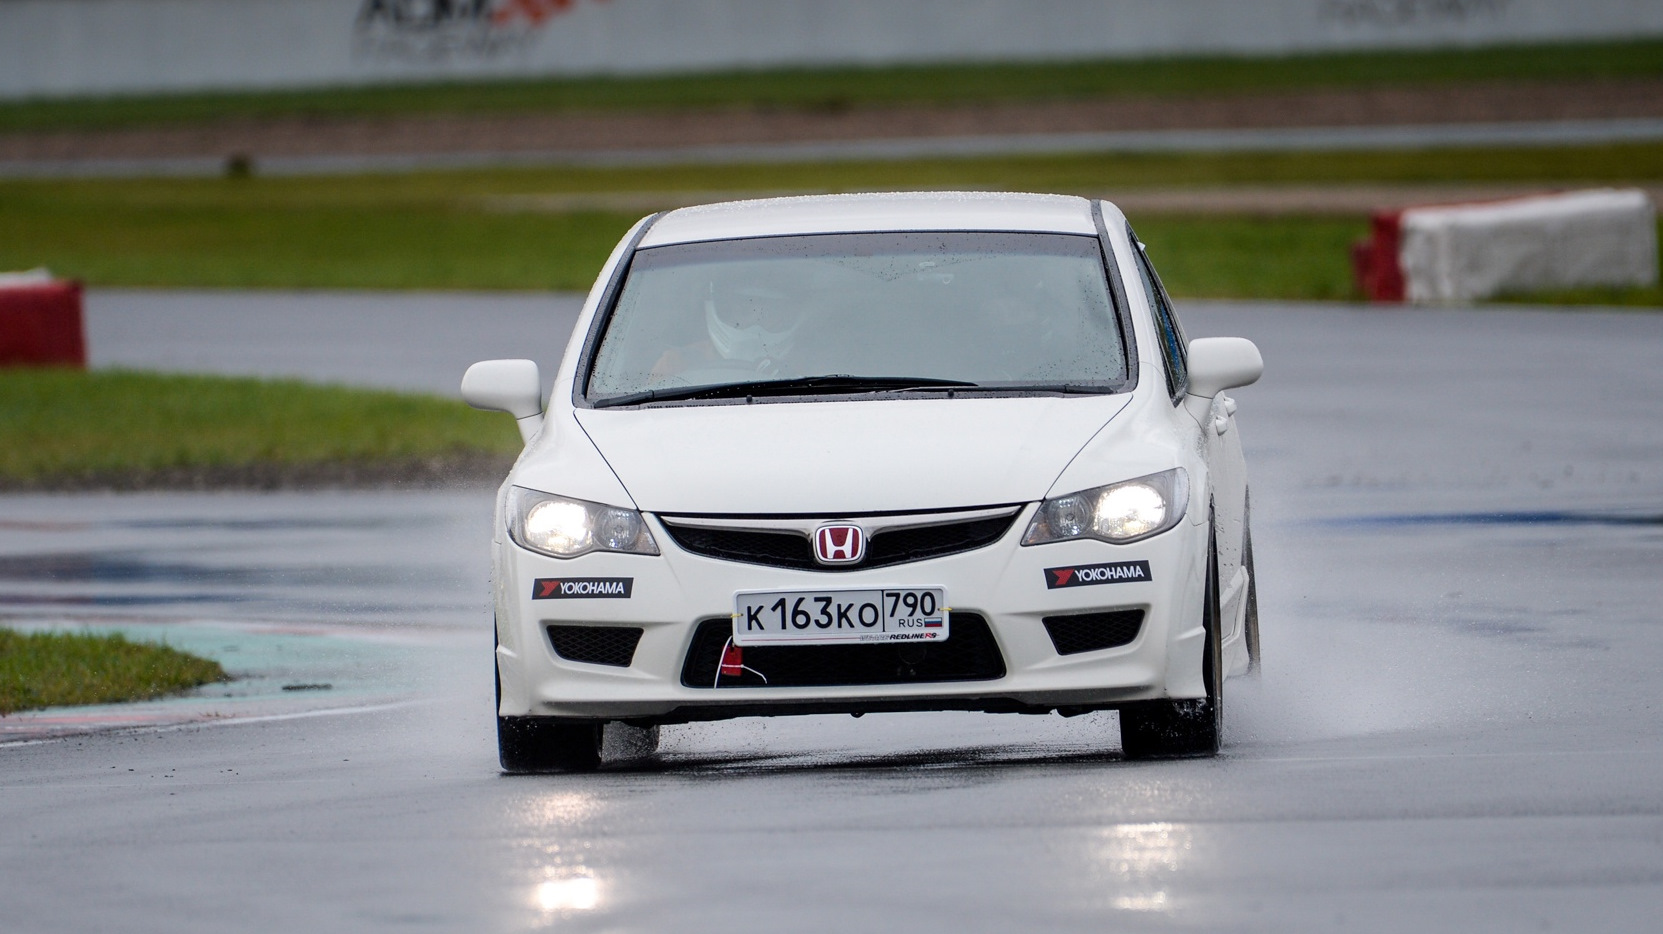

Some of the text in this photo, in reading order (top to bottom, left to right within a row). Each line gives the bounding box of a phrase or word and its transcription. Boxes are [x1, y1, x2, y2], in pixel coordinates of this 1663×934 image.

[1074, 565, 1145, 582] YOKOHAMA
[560, 581, 624, 595] YOKOHAMA
[885, 591, 936, 618] 790
[898, 618, 924, 628] RUS
